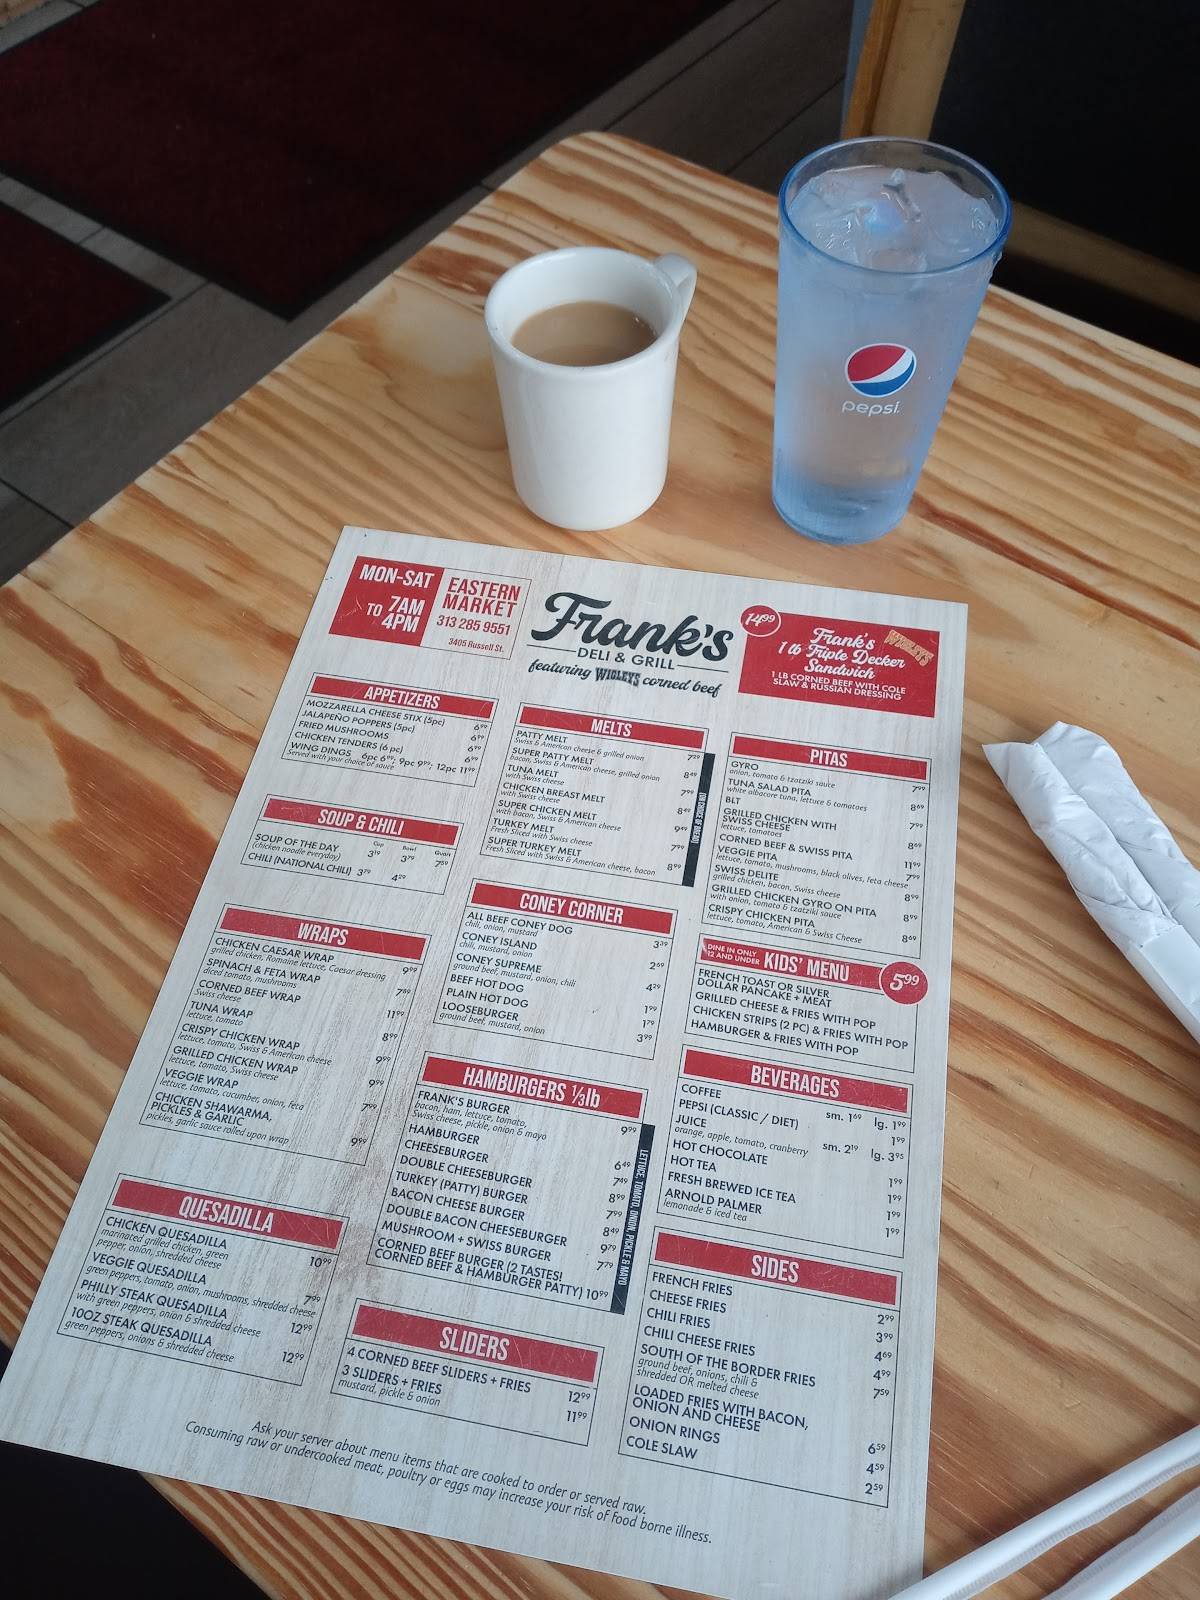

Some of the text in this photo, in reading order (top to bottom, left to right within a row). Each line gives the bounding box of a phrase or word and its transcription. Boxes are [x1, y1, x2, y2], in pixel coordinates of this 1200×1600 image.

[842, 400, 901, 417] pepsi
[359, 563, 435, 588] MON-SAT
[447, 576, 521, 601] EASTERN
[366, 602, 383, 617] TO
[387, 595, 425, 615] 7AM
[441, 593, 517, 618] MARKET
[381, 612, 420, 632] 4PM
[436, 614, 510, 635] 313 285 9551
[530, 591, 733, 661] Frank's
[448, 637, 504, 652] 3405 Russell St.
[809, 627, 875, 650] Frank's
[577, 647, 674, 670] DELI & GRILL
[803, 657, 875, 679] Sandwich
[527, 658, 592, 680] featuring
[642, 677, 692, 690] corned
[691, 680, 722, 698] beef
[772, 677, 800, 687] SLAW
[810, 682, 852, 694] RUSSIAN
[853, 687, 901, 700] DRESSING
[778, 671, 788, 679] LB
[790, 673, 830, 684] CORNED
[832, 678, 853, 687] BEEF
[854, 681, 879, 691] WITH
[881, 684, 906, 694] COLE
[363, 686, 440, 709] APPETIZERS
[305, 699, 445, 727] MOZZARELLA CHEESE STIX (5pc)
[298, 720, 389, 739] FRIED MUSHROOMS
[516, 729, 568, 743] PATTY MELT
[590, 718, 632, 737] MELTS
[809, 748, 847, 767] PITAS
[502, 782, 605, 803] CHICKEN BREAST MELT
[728, 777, 811, 796] TUNA SALAD PITA
[725, 795, 741, 805] BLT
[317, 808, 404, 835] SOUP & CHILI
[254, 833, 339, 852] SOUP OF THE DAY
[519, 892, 623, 924] CONEY CORNER
[297, 922, 348, 945] WRAPS
[466, 911, 572, 934] ALL BEEF CONEY DOG
[215, 937, 334, 962] CHICKEN CAESAR WRAP
[461, 931, 537, 950] CONEY ISLAND
[806, 958, 849, 981] MENU
[442, 1000, 518, 1021] LOOSEBURGER
[690, 1019, 858, 1055] HAMBURGER & FRIES WITH POP
[165, 1067, 238, 1089] VEGGIE WRAP
[462, 1066, 566, 1101] HAMBURGERS
[750, 1064, 839, 1098] BEVERAGES
[417, 1090, 510, 1114] FRANK'S BURGER
[681, 1083, 721, 1099] COFFEE
[675, 1114, 706, 1128] JUICE
[408, 1123, 479, 1145] HAMBURGER
[404, 1139, 488, 1163] CHEESEBURGER
[672, 1138, 768, 1165] HOT CHOCOLATE
[399, 1154, 532, 1188] DOUBLE CHEESEBURGER
[178, 1195, 274, 1233] QUESADILLA
[105, 1216, 226, 1249] CHICKEN QUESADILLA
[750, 1254, 799, 1283] SIDES
[652, 1271, 732, 1296] FRENCH FRIES
[80, 1279, 227, 1319] PHILLY STEAK QUESADILLA
[439, 1326, 509, 1361] SLIDERS
[341, 1364, 442, 1395] 3 SLIDERS + FRIES
[629, 1415, 720, 1444] ONION RINGS
[626, 1435, 698, 1459] COLE SLAW
[251, 1420, 646, 1515] Ask your server about menu items that are cooked to order or served raw.
[185, 1420, 711, 1543] Consuming raw or undercooked meat, poultry or eggs may increase your risk of food borne illness.
